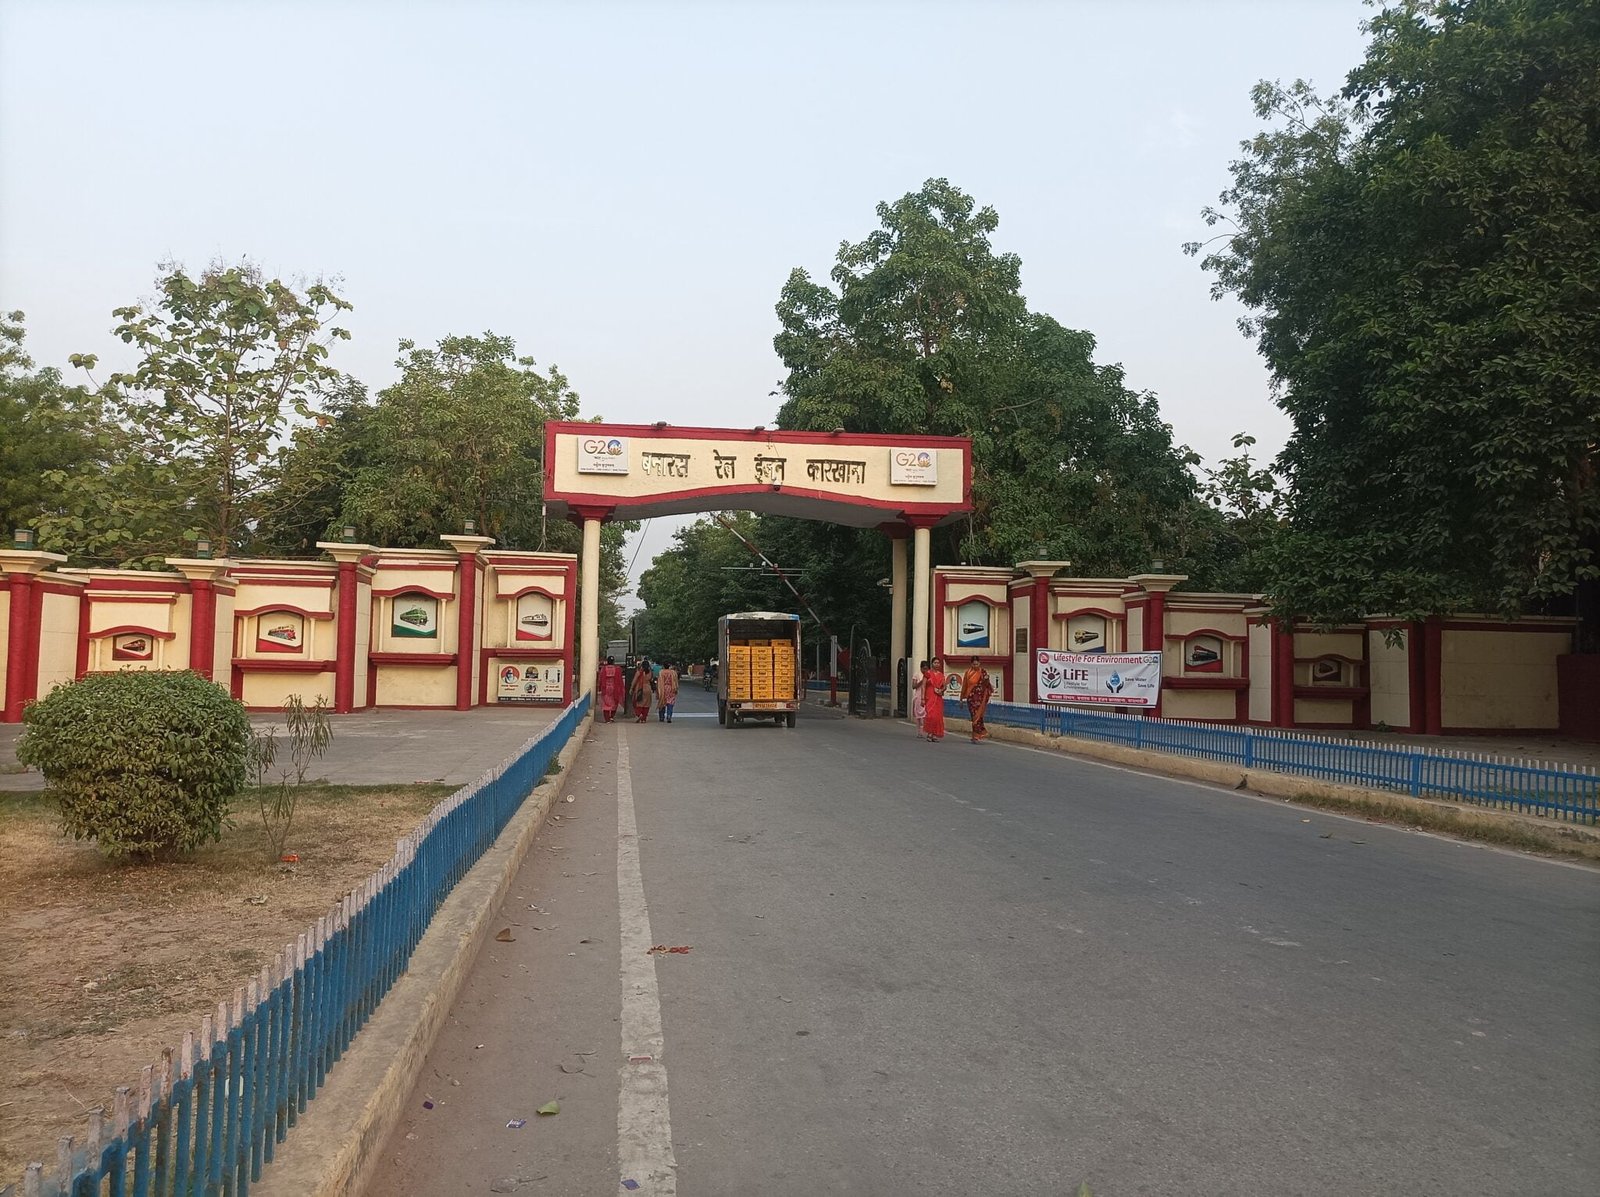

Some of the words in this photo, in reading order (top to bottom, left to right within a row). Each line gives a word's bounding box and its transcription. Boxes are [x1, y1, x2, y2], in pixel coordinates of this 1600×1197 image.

[642, 451, 691, 478] बनारस
[713, 449, 737, 479] रेल
[806, 459, 867, 484] कारखाना
[1054, 653, 1082, 663] Lifestyle
[1083, 655, 1095, 663] For
[1096, 655, 1143, 664] Environment
[1063, 669, 1089, 681] LiFE
